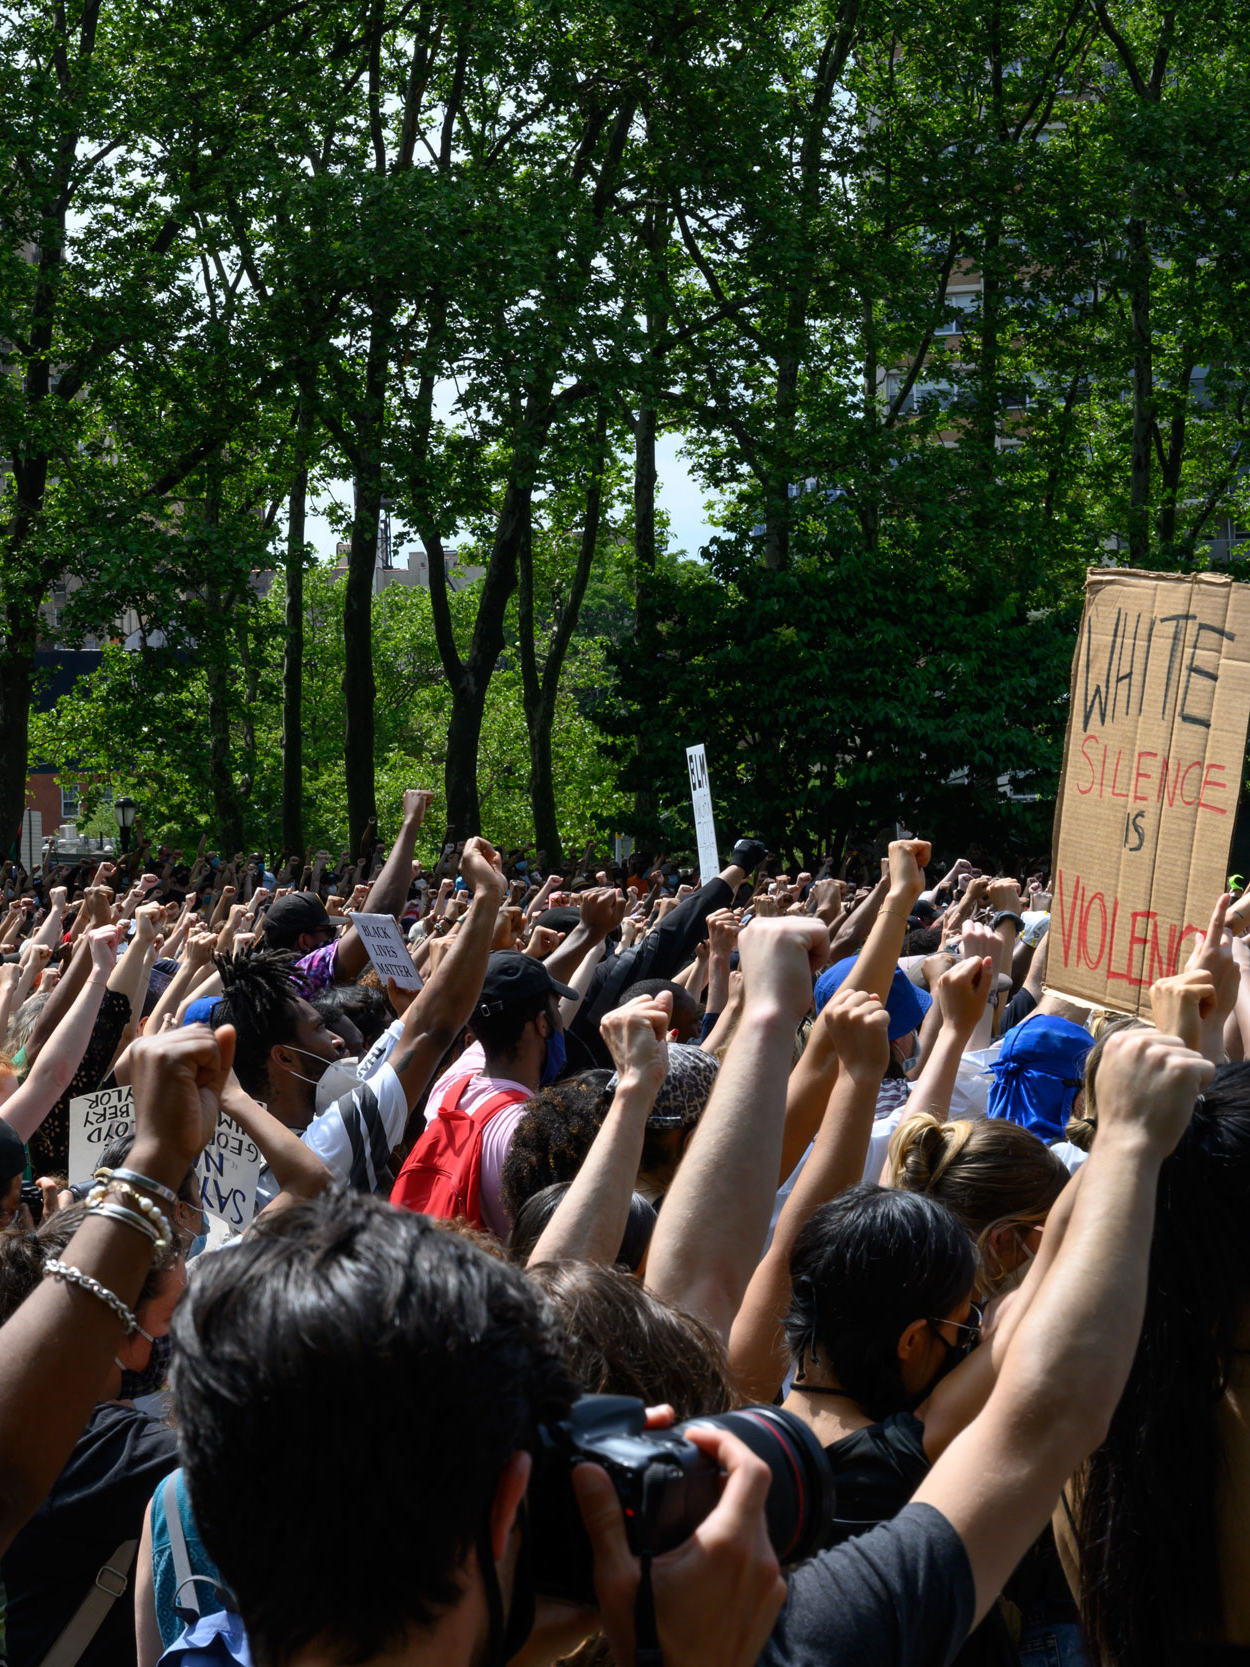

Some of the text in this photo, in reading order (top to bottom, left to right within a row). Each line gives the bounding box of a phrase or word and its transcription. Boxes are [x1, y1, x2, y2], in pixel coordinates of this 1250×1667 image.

[1082, 606, 1236, 733] WHITE
[688, 753, 708, 791] BLM
[1076, 734, 1228, 815] SILENCE
[1123, 810, 1146, 852] IS
[361, 924, 391, 939] BLACK
[1058, 868, 1208, 986] VIOLENC
[372, 943, 398, 958] LIVES
[376, 962, 413, 977] MATTER
